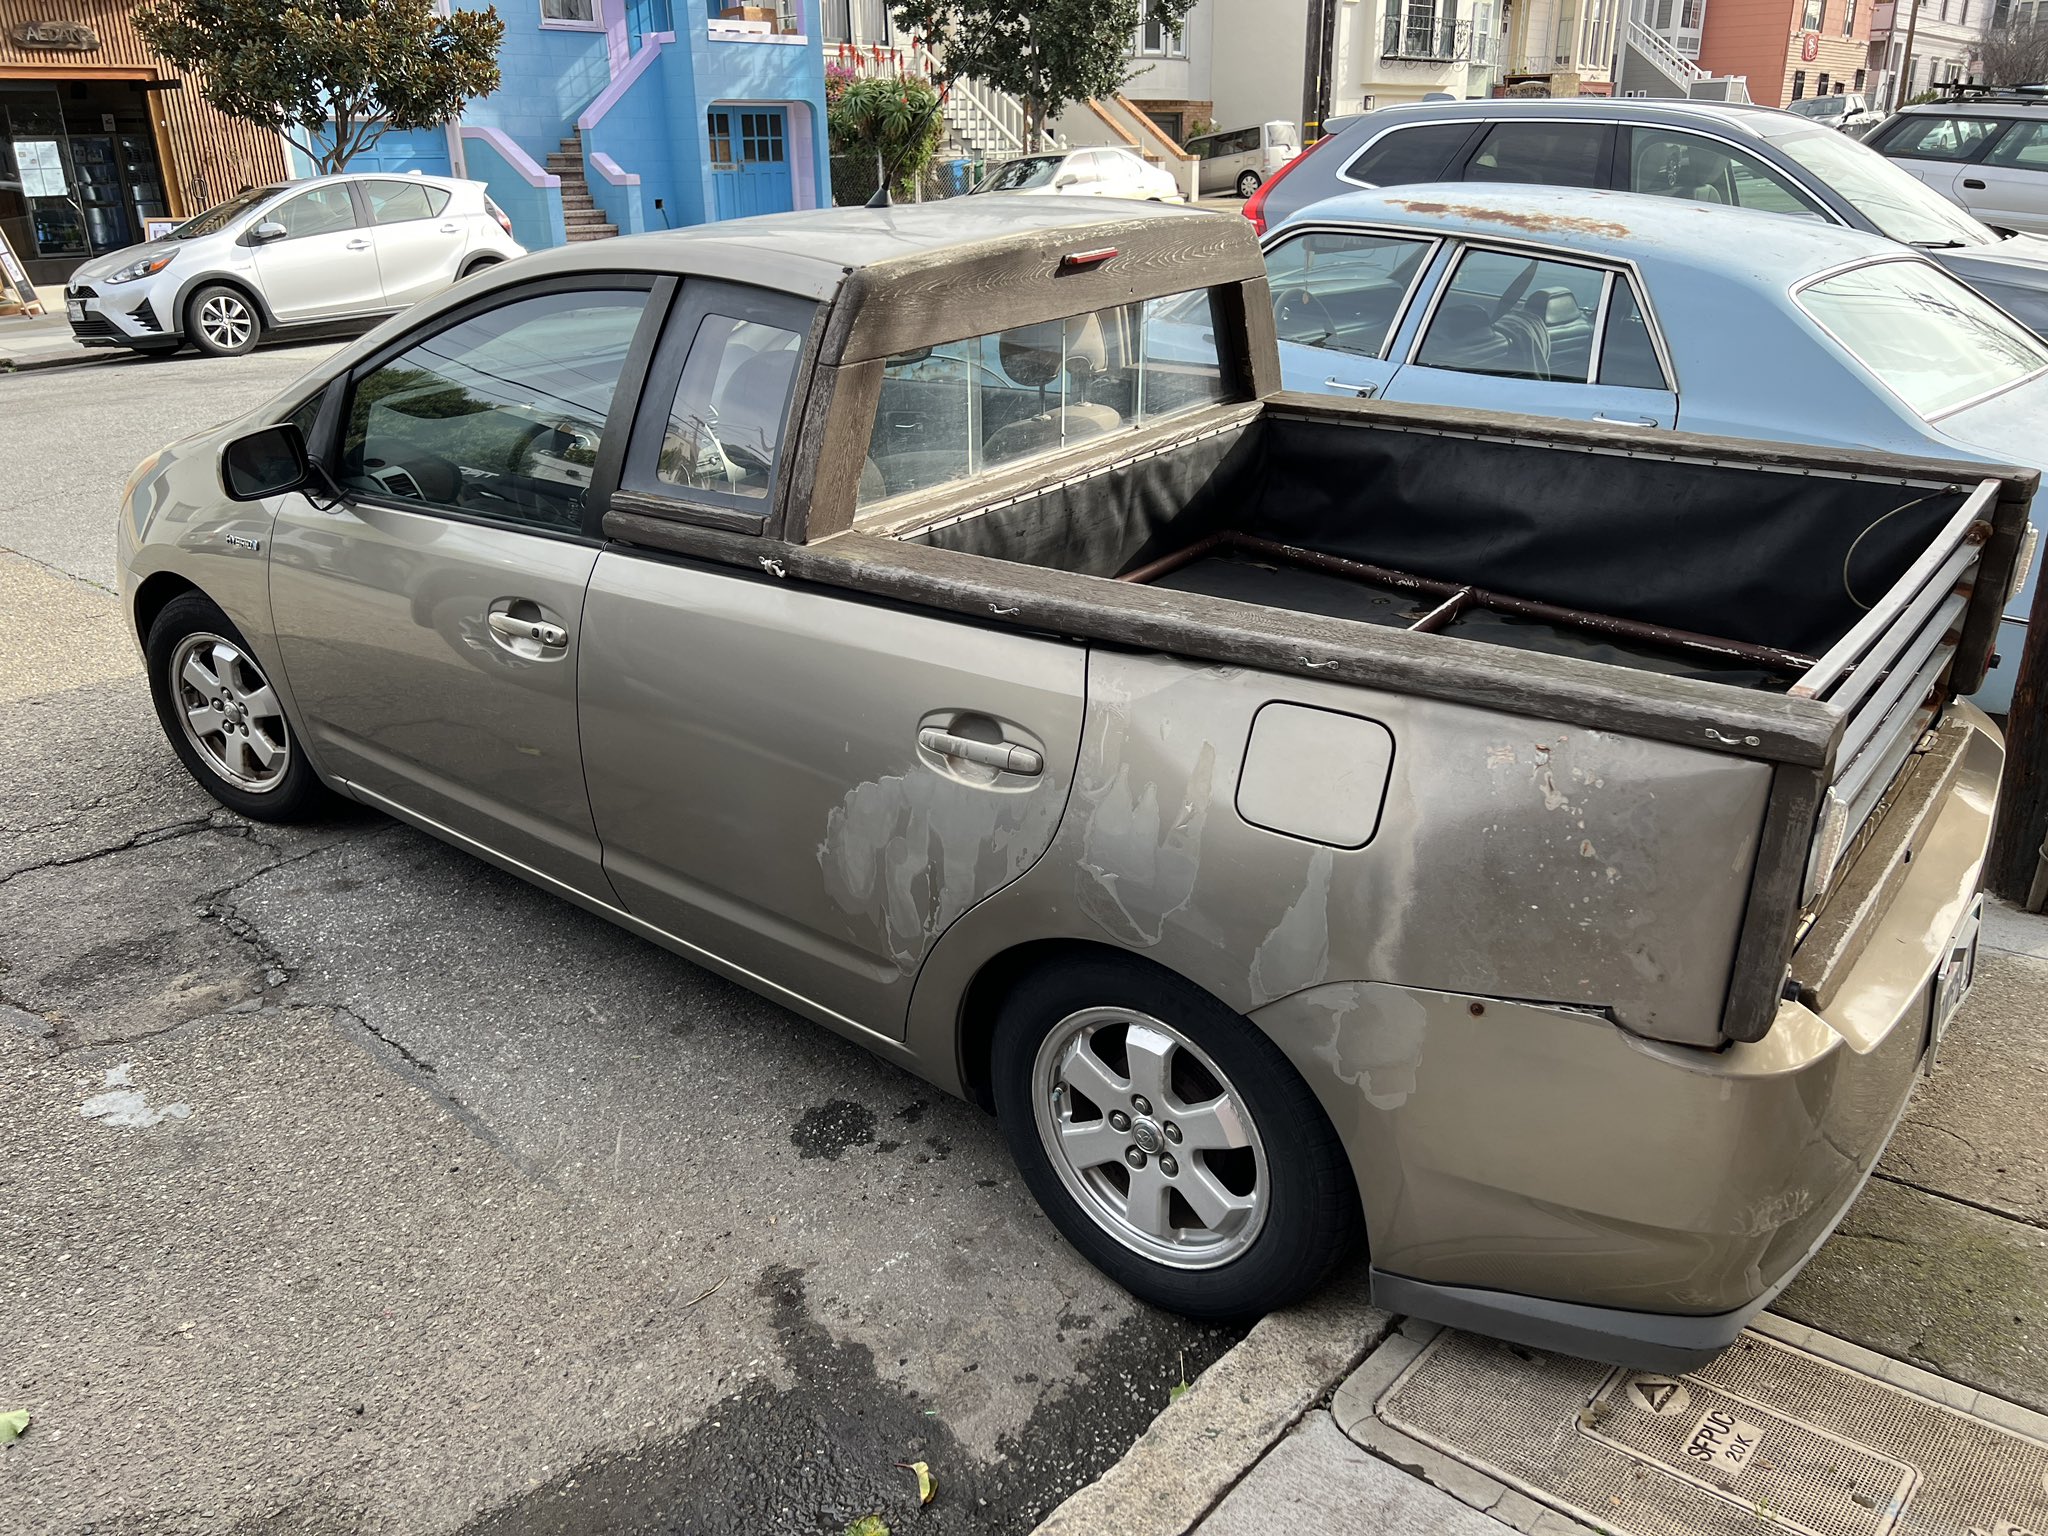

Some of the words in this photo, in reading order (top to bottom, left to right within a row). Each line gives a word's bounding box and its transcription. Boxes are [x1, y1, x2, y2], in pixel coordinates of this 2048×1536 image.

[26, 26, 80, 41] AEDAN
[1688, 1410, 1735, 1462] SFPUC
[1725, 1433, 1753, 1463] 20K
